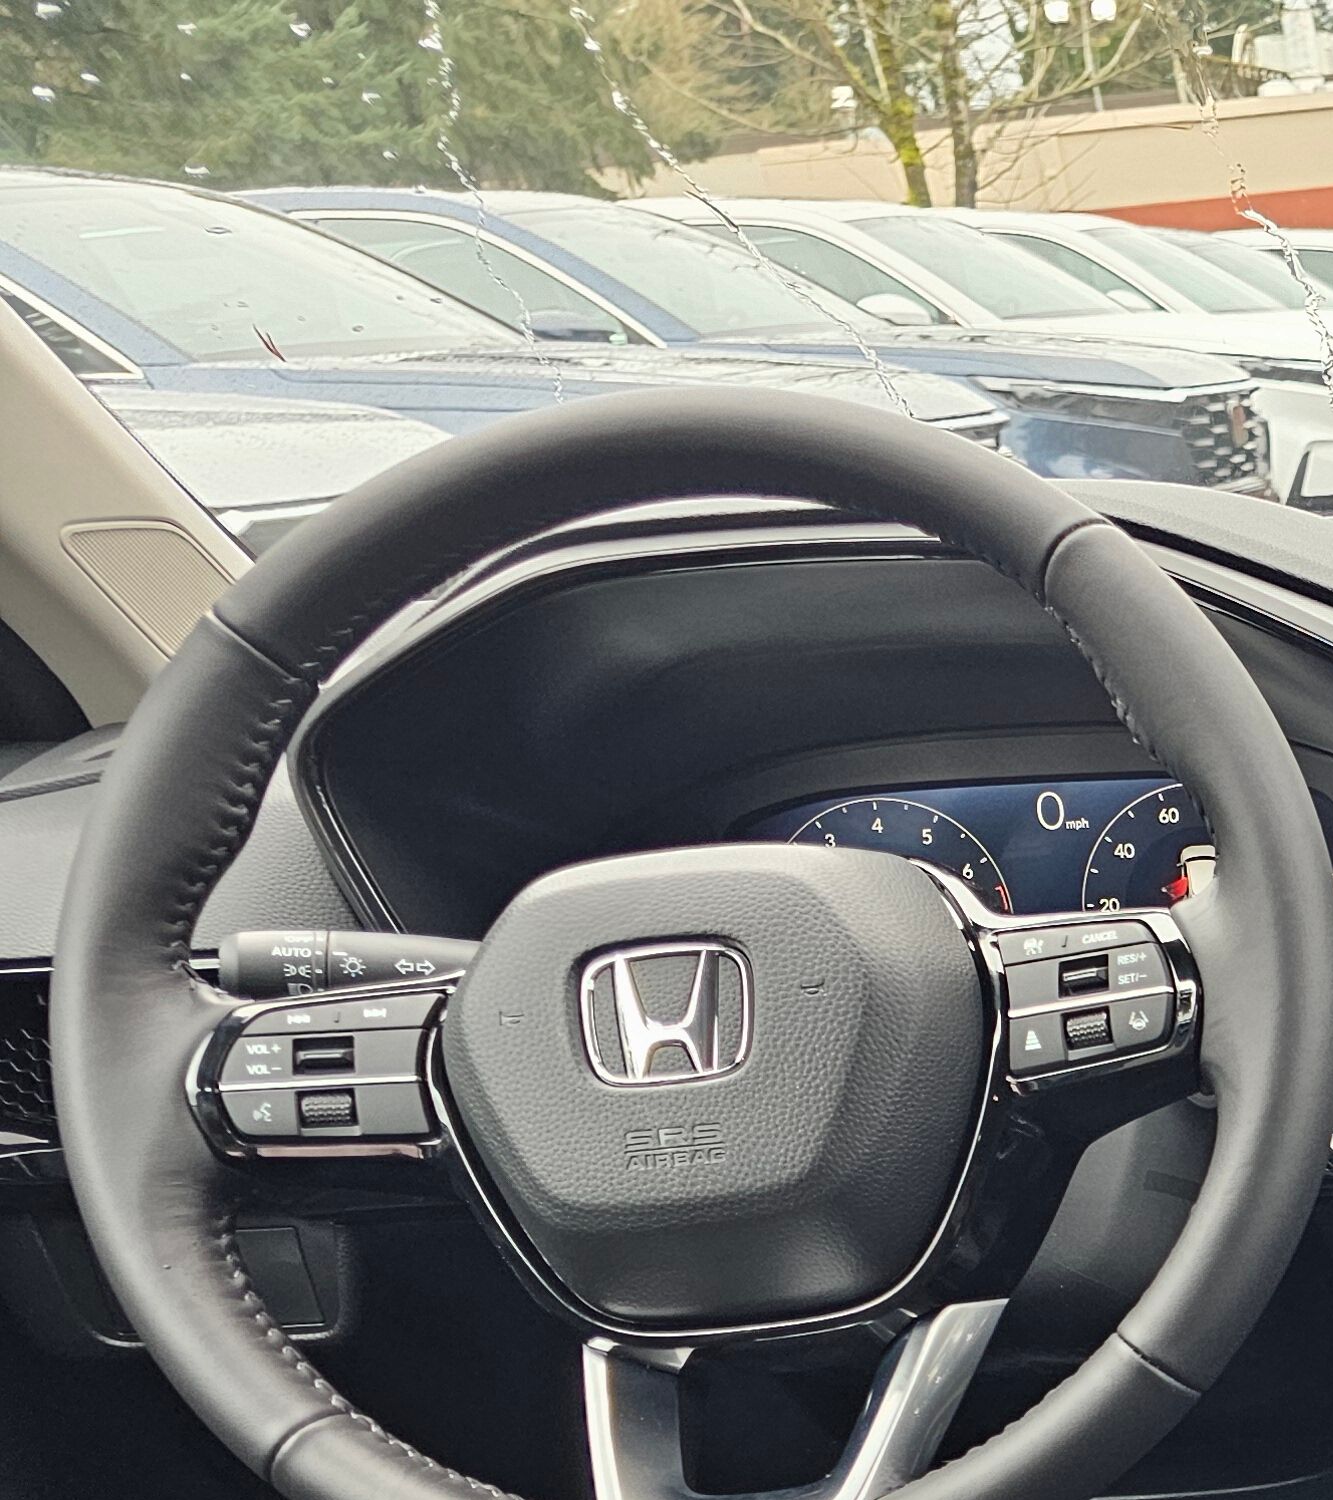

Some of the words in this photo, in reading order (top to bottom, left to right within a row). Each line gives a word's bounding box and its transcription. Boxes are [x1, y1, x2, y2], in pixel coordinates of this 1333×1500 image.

[1036, 791, 1065, 831] 0
[1065, 818, 1090, 831] mph
[1158, 807, 1180, 825] 60
[871, 818, 884, 834] 4
[824, 834, 836, 849] 3
[922, 829, 933, 845] 5
[1114, 843, 1136, 859] 40
[962, 864, 974, 879] 6
[1099, 898, 1121, 914] 20
[1081, 931, 1118, 945] CANCEL
[271, 946, 312, 958] AUTO
[624, 1122, 721, 1149] SRS
[626, 1146, 726, 1171] AIRBAG
